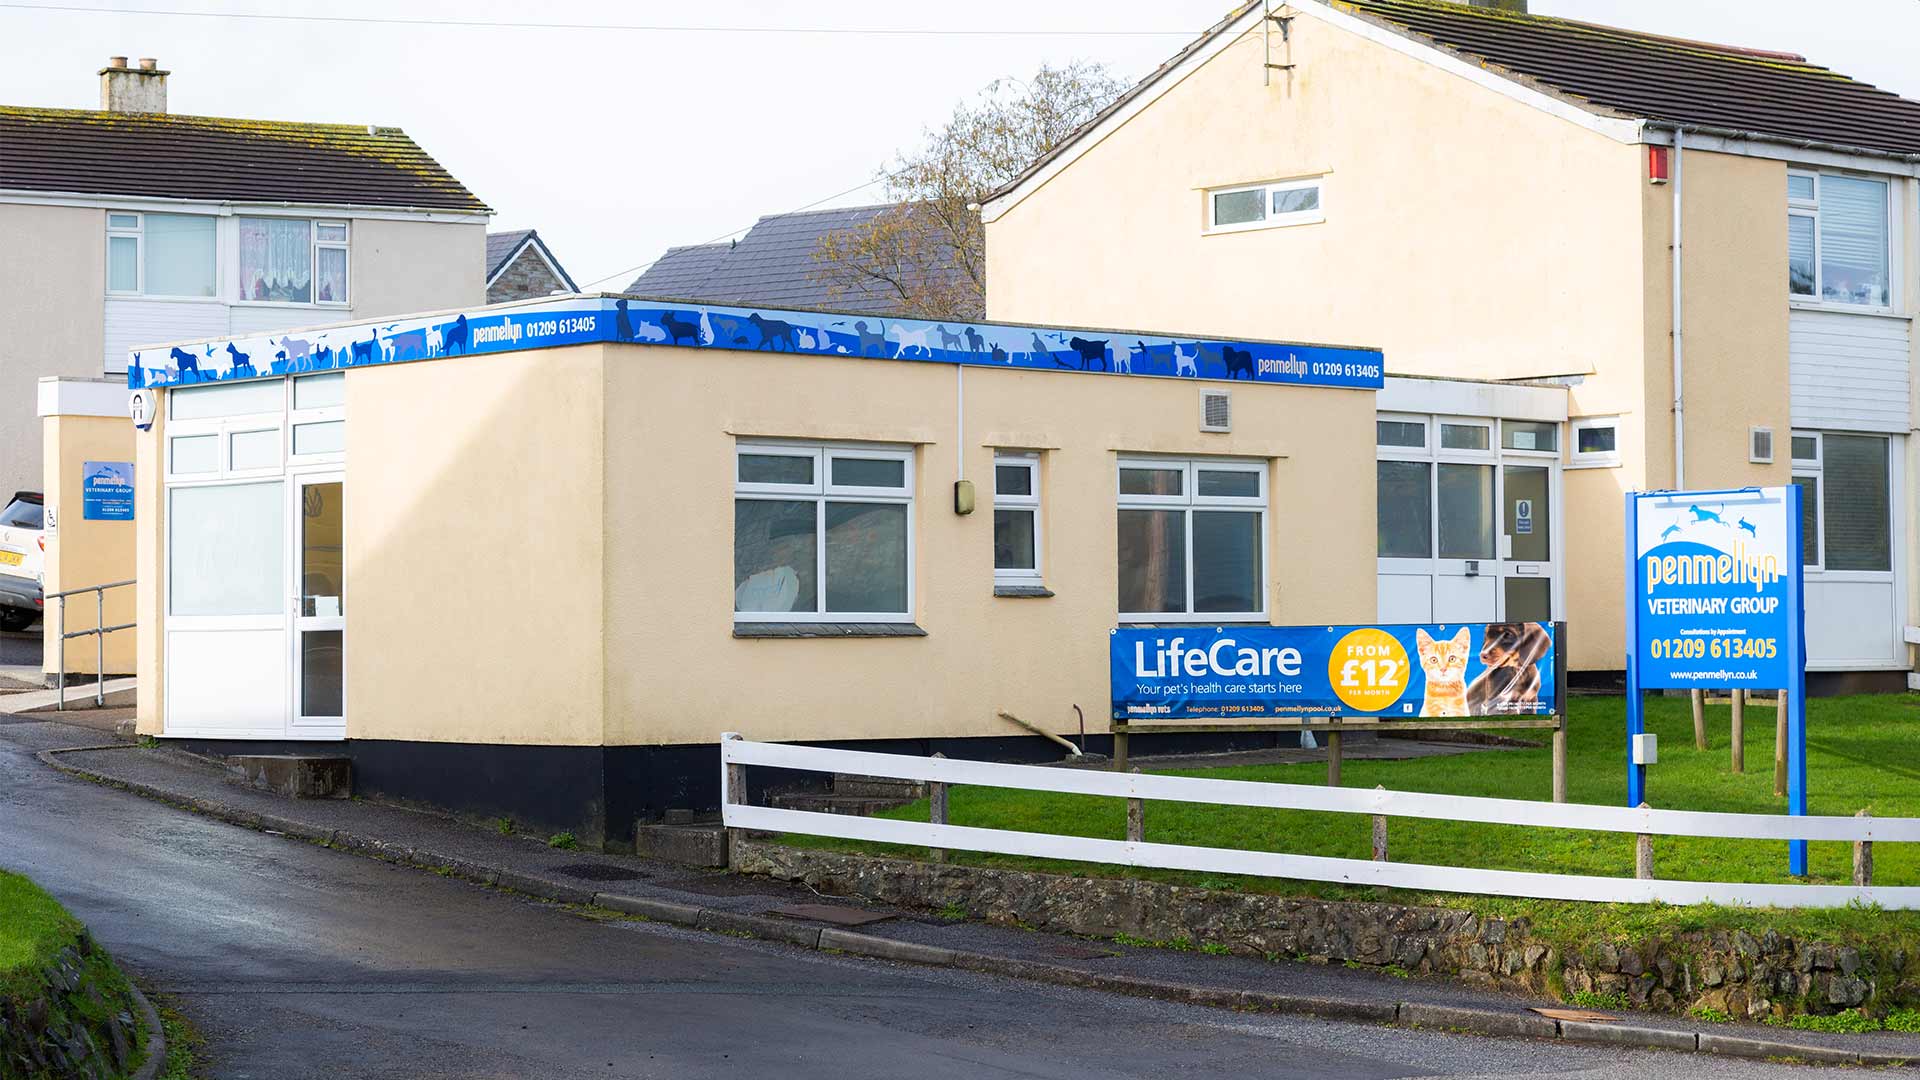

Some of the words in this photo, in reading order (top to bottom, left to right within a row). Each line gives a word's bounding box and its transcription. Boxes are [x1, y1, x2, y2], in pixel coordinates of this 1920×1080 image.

[473, 316, 523, 349] penmellyn
[526, 322, 557, 338] 01209
[558, 316, 596, 334] 613405
[1258, 353, 1308, 378] penmellyn
[1312, 363, 1342, 376] 01209
[1344, 364, 1380, 378] 613405
[1647, 539, 1779, 595] penmellyn
[1647, 598, 1728, 615] VETERINARY
[1730, 597, 1779, 614] GROUP
[1135, 637, 1302, 677] LifeCare
[1347, 645, 1390, 656] FROM
[1651, 638, 1705, 659] 01209
[1710, 637, 1777, 659] 613405
[1670, 669, 1758, 682] www.penmellyn.co.uk
[1136, 683, 1161, 695] Your
[1163, 683, 1189, 696] pet's
[1190, 682, 1222, 694] health
[1224, 683, 1246, 694] care
[1248, 683, 1277, 694] starts
[1278, 681, 1302, 694] here
[1241, 705, 1265, 713] 613405
[1274, 705, 1342, 713] penmellynpool.co.uk
